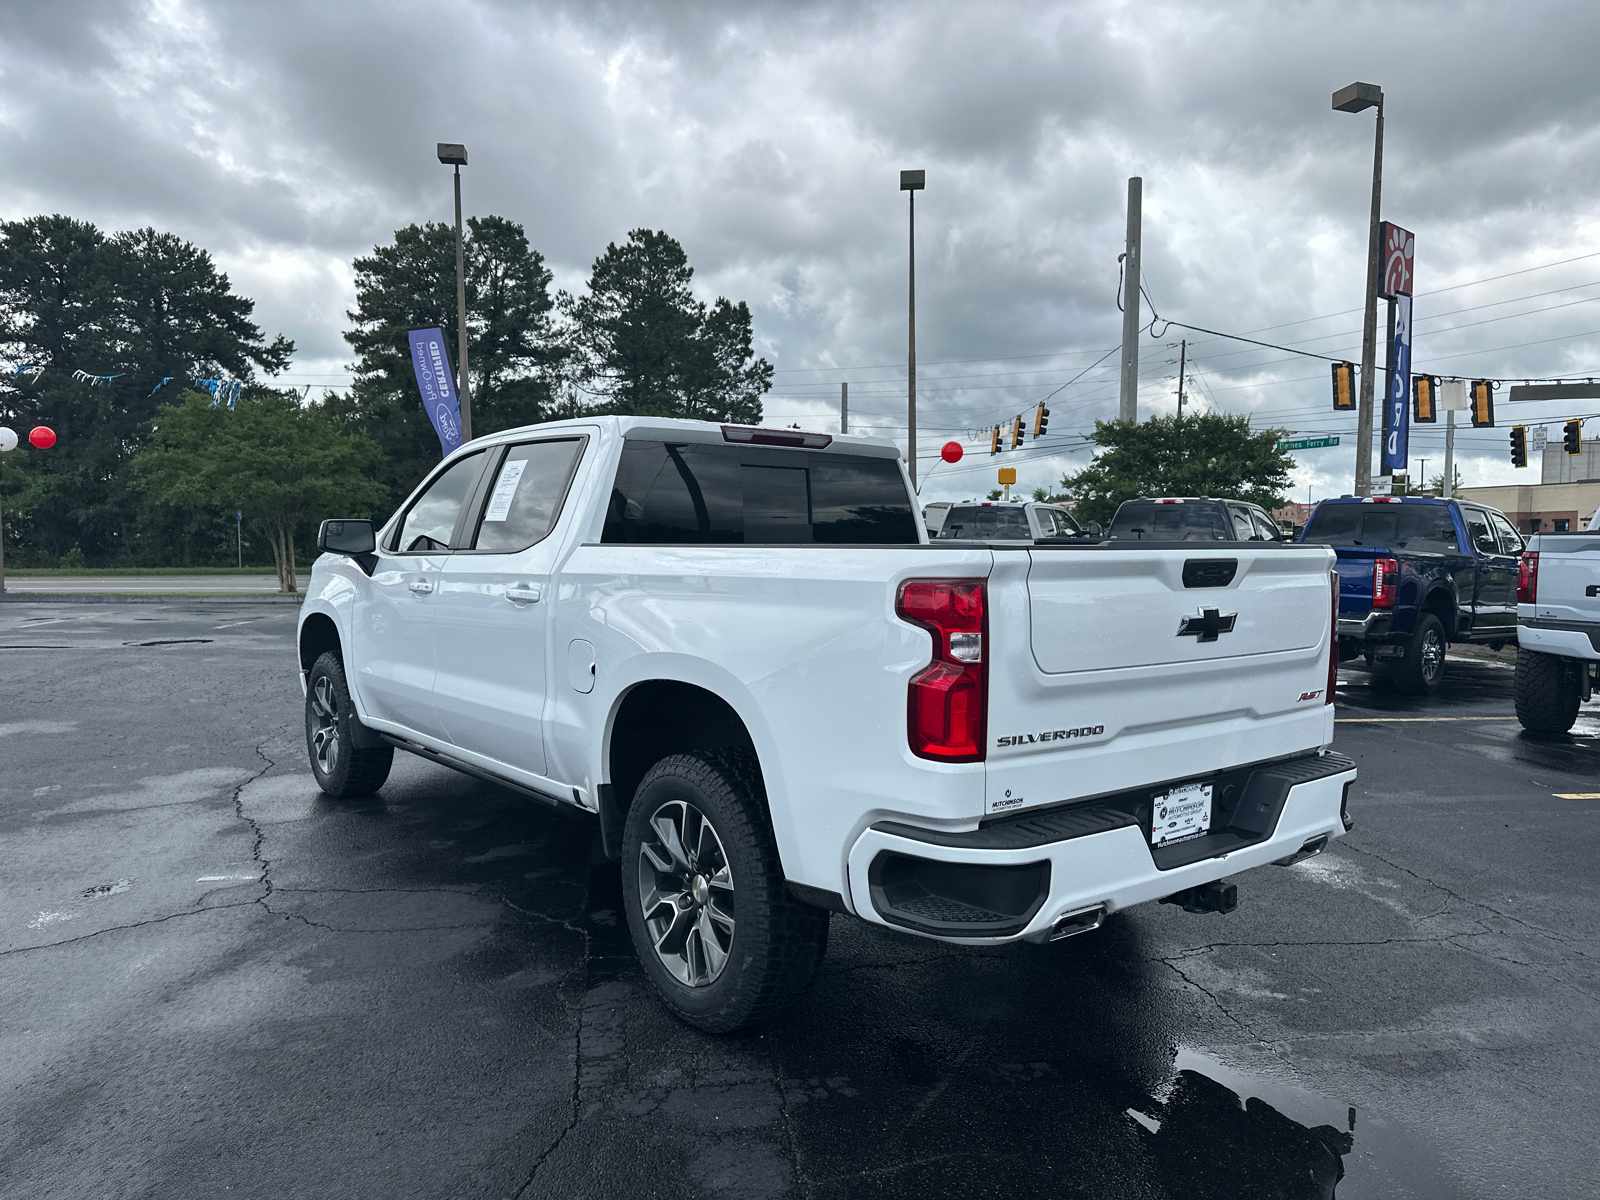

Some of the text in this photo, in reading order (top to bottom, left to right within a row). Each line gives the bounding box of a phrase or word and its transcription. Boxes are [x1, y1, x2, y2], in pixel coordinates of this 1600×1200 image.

[1306, 440, 1325, 448] Ferry
[1296, 689, 1324, 702] RST
[997, 725, 1104, 747] SILVERADO
[992, 797, 1024, 808] HUTCHINSON
[1168, 800, 1205, 815] HUTCHINSON
[1190, 808, 1203, 816] GROUP
